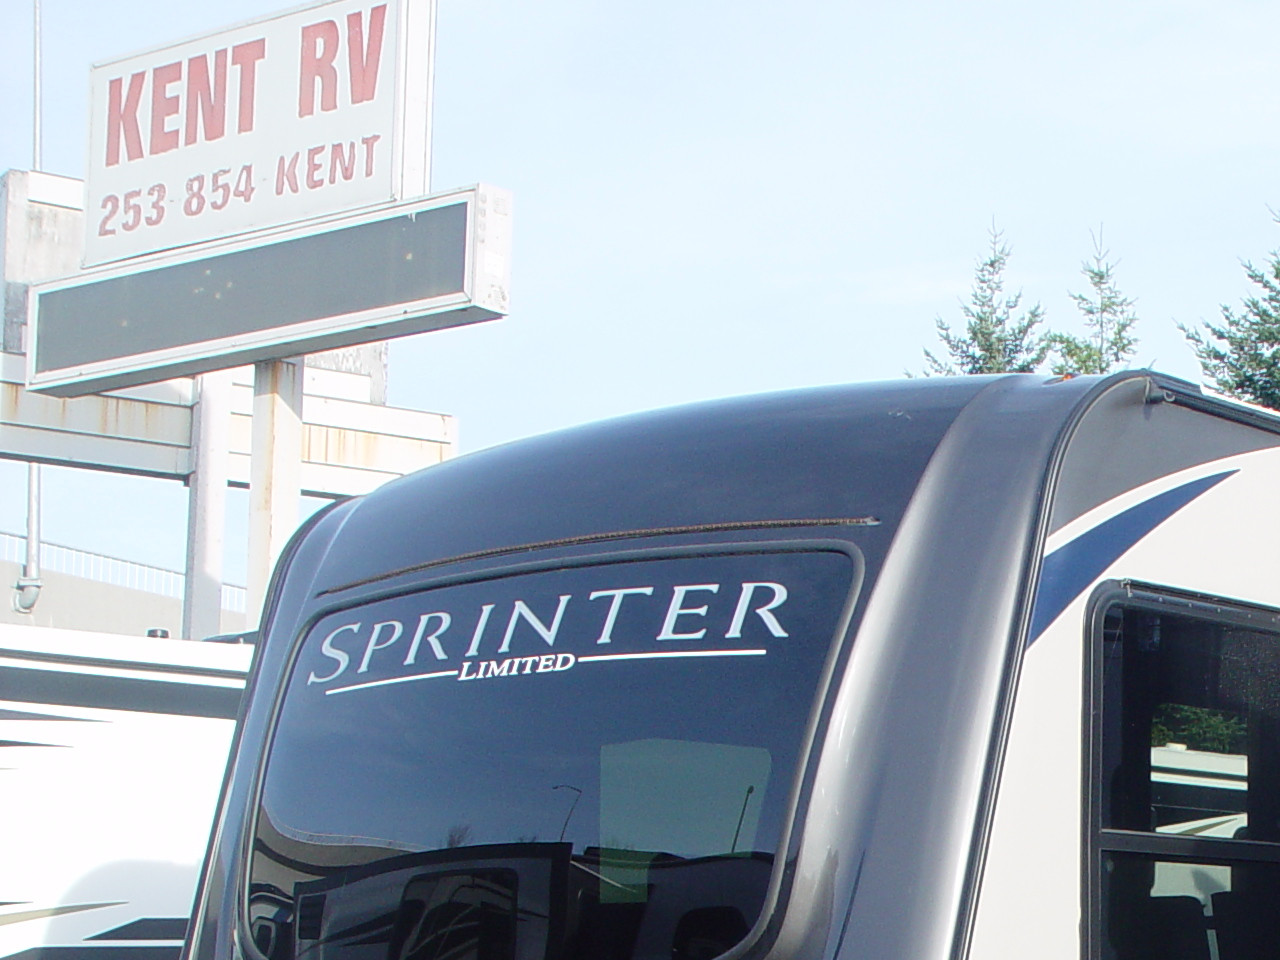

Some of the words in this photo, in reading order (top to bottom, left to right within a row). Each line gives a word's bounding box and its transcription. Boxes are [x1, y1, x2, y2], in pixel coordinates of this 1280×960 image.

[105, 37, 266, 168] KENT
[298, 3, 388, 119] RV
[98, 183, 167, 237] 253
[183, 163, 255, 217] 854
[275, 134, 382, 196] KENT
[307, 581, 789, 685] SPRINTER
[457, 652, 576, 681] LIMITED
